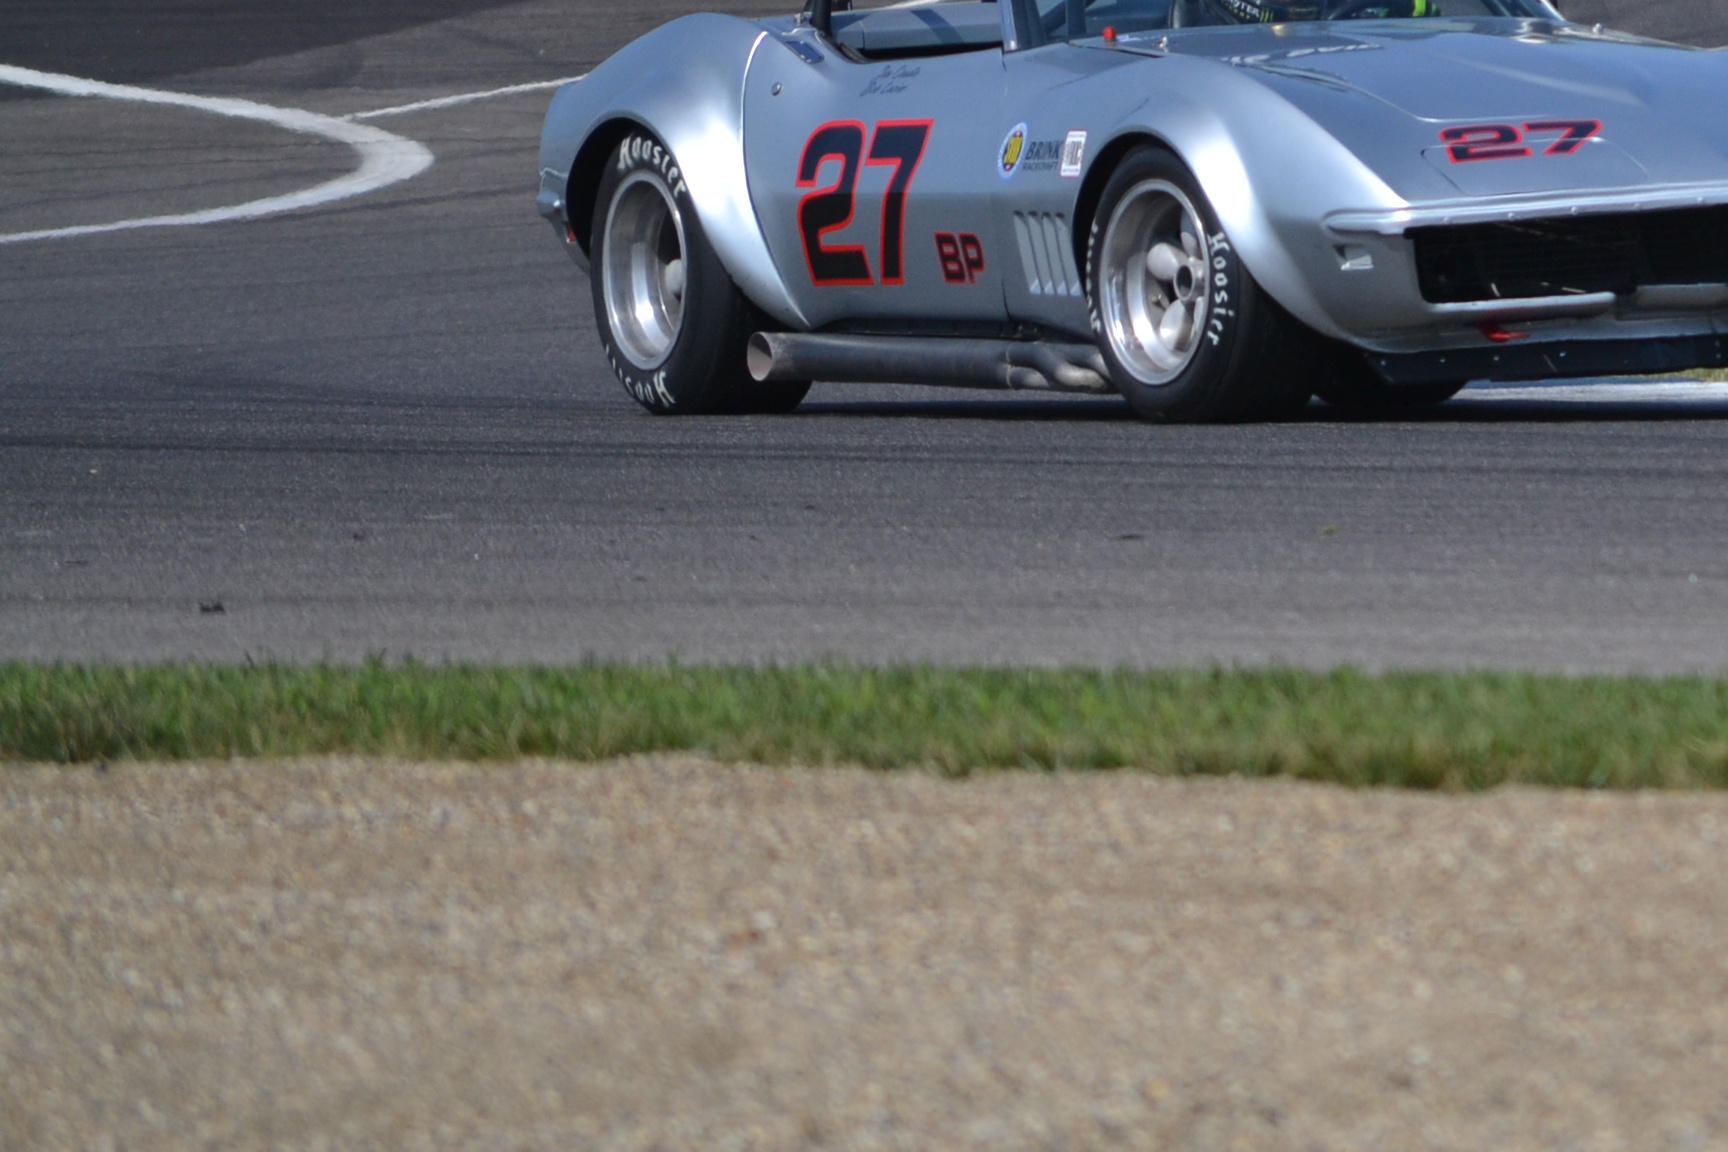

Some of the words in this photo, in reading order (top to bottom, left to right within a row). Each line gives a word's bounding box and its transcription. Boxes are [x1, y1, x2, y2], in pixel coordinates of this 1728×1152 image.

[617, 134, 687, 197] Hoosier
[1439, 119, 1603, 164] 27
[795, 118, 935, 286] 27
[934, 231, 985, 284] BP
[1206, 232, 1235, 346] Hoosier
